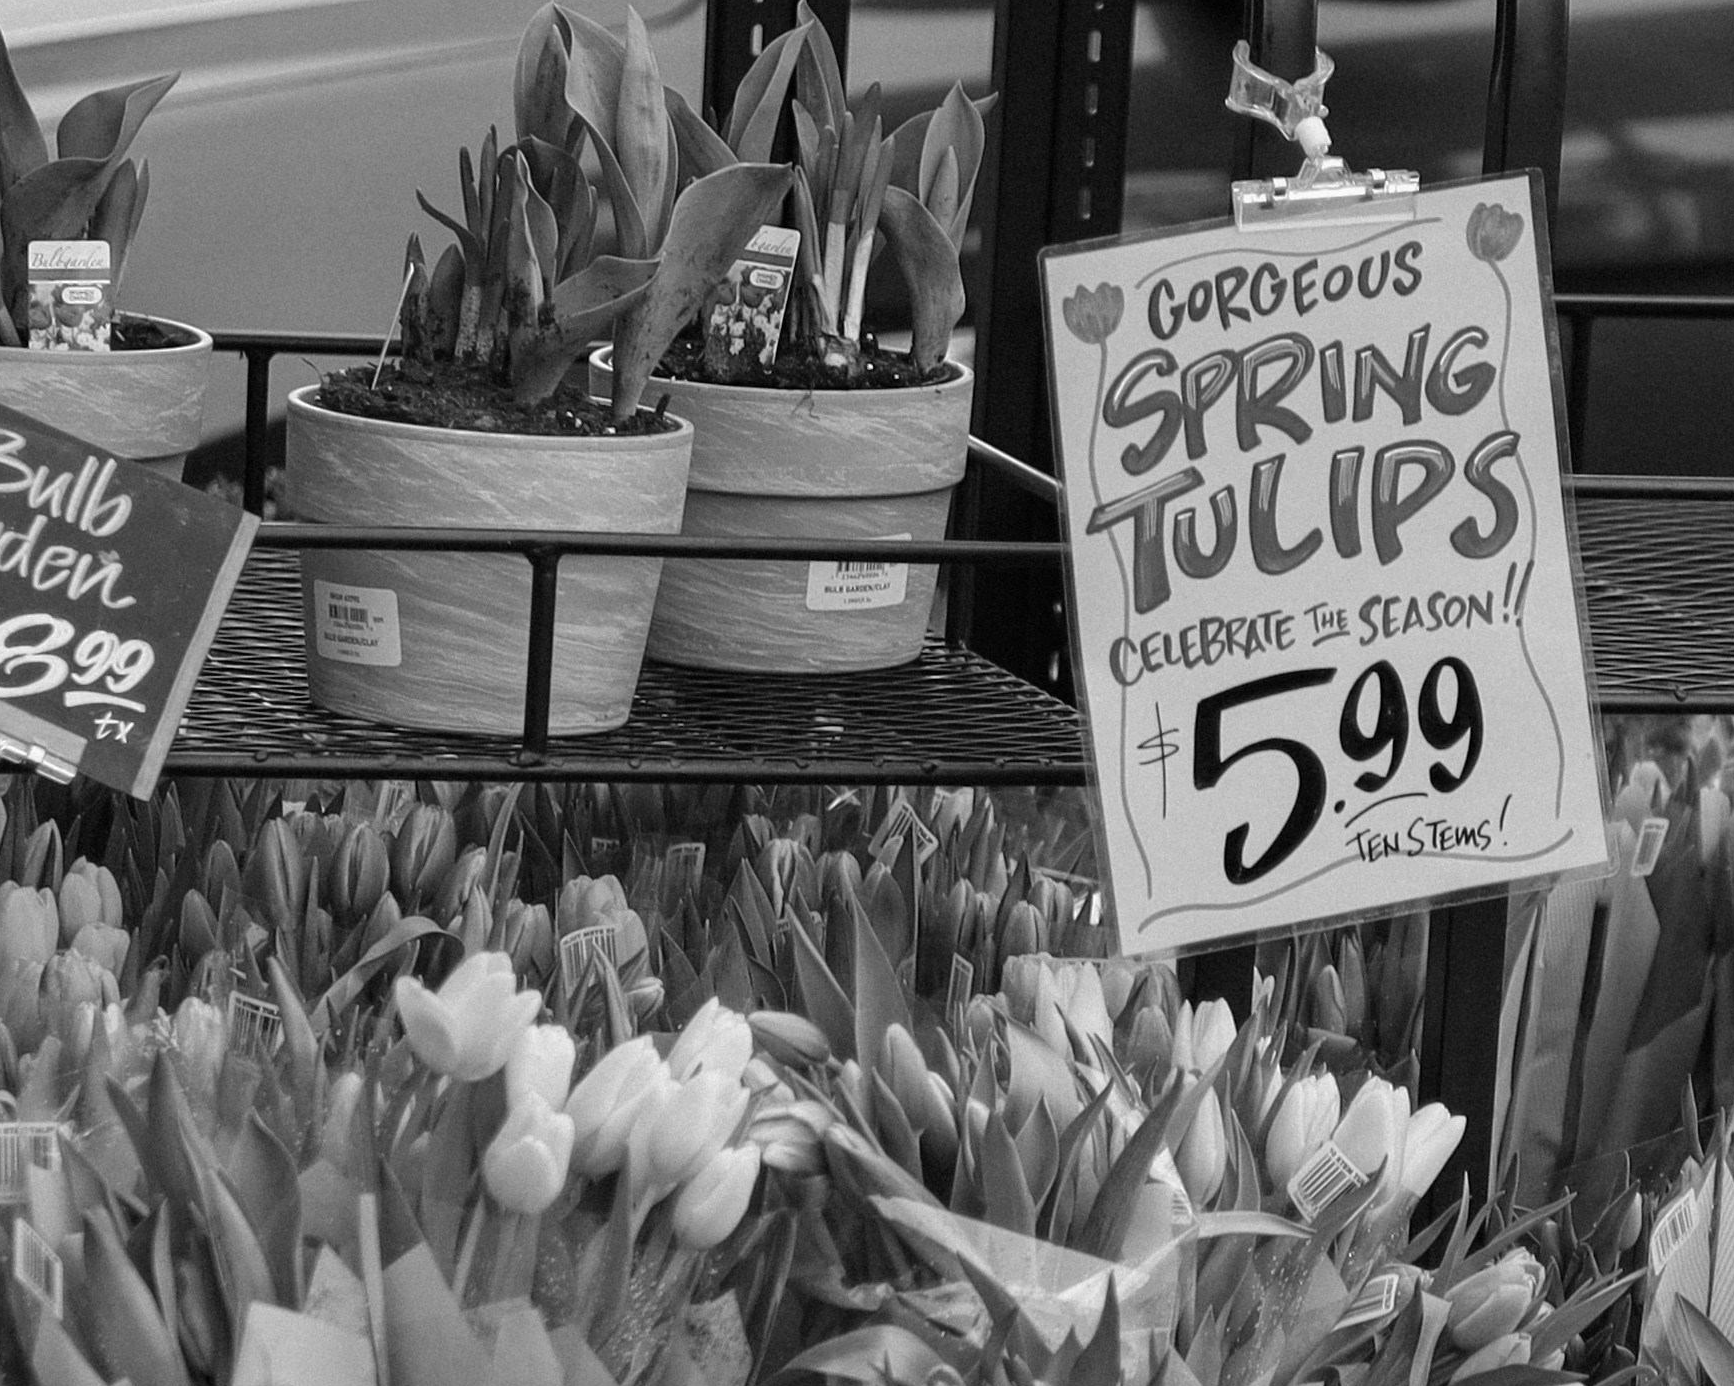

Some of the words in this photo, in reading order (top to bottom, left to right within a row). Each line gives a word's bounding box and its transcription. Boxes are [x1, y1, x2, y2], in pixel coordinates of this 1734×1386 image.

[1148, 240, 1425, 341] GORGEOUS
[1103, 323, 1498, 476] SPRING
[1086, 429, 1522, 616] TULIPS
[1109, 604, 1297, 687] CELEBRATE
[1306, 600, 1351, 637] THE
[1345, 828, 1400, 863] TEN
